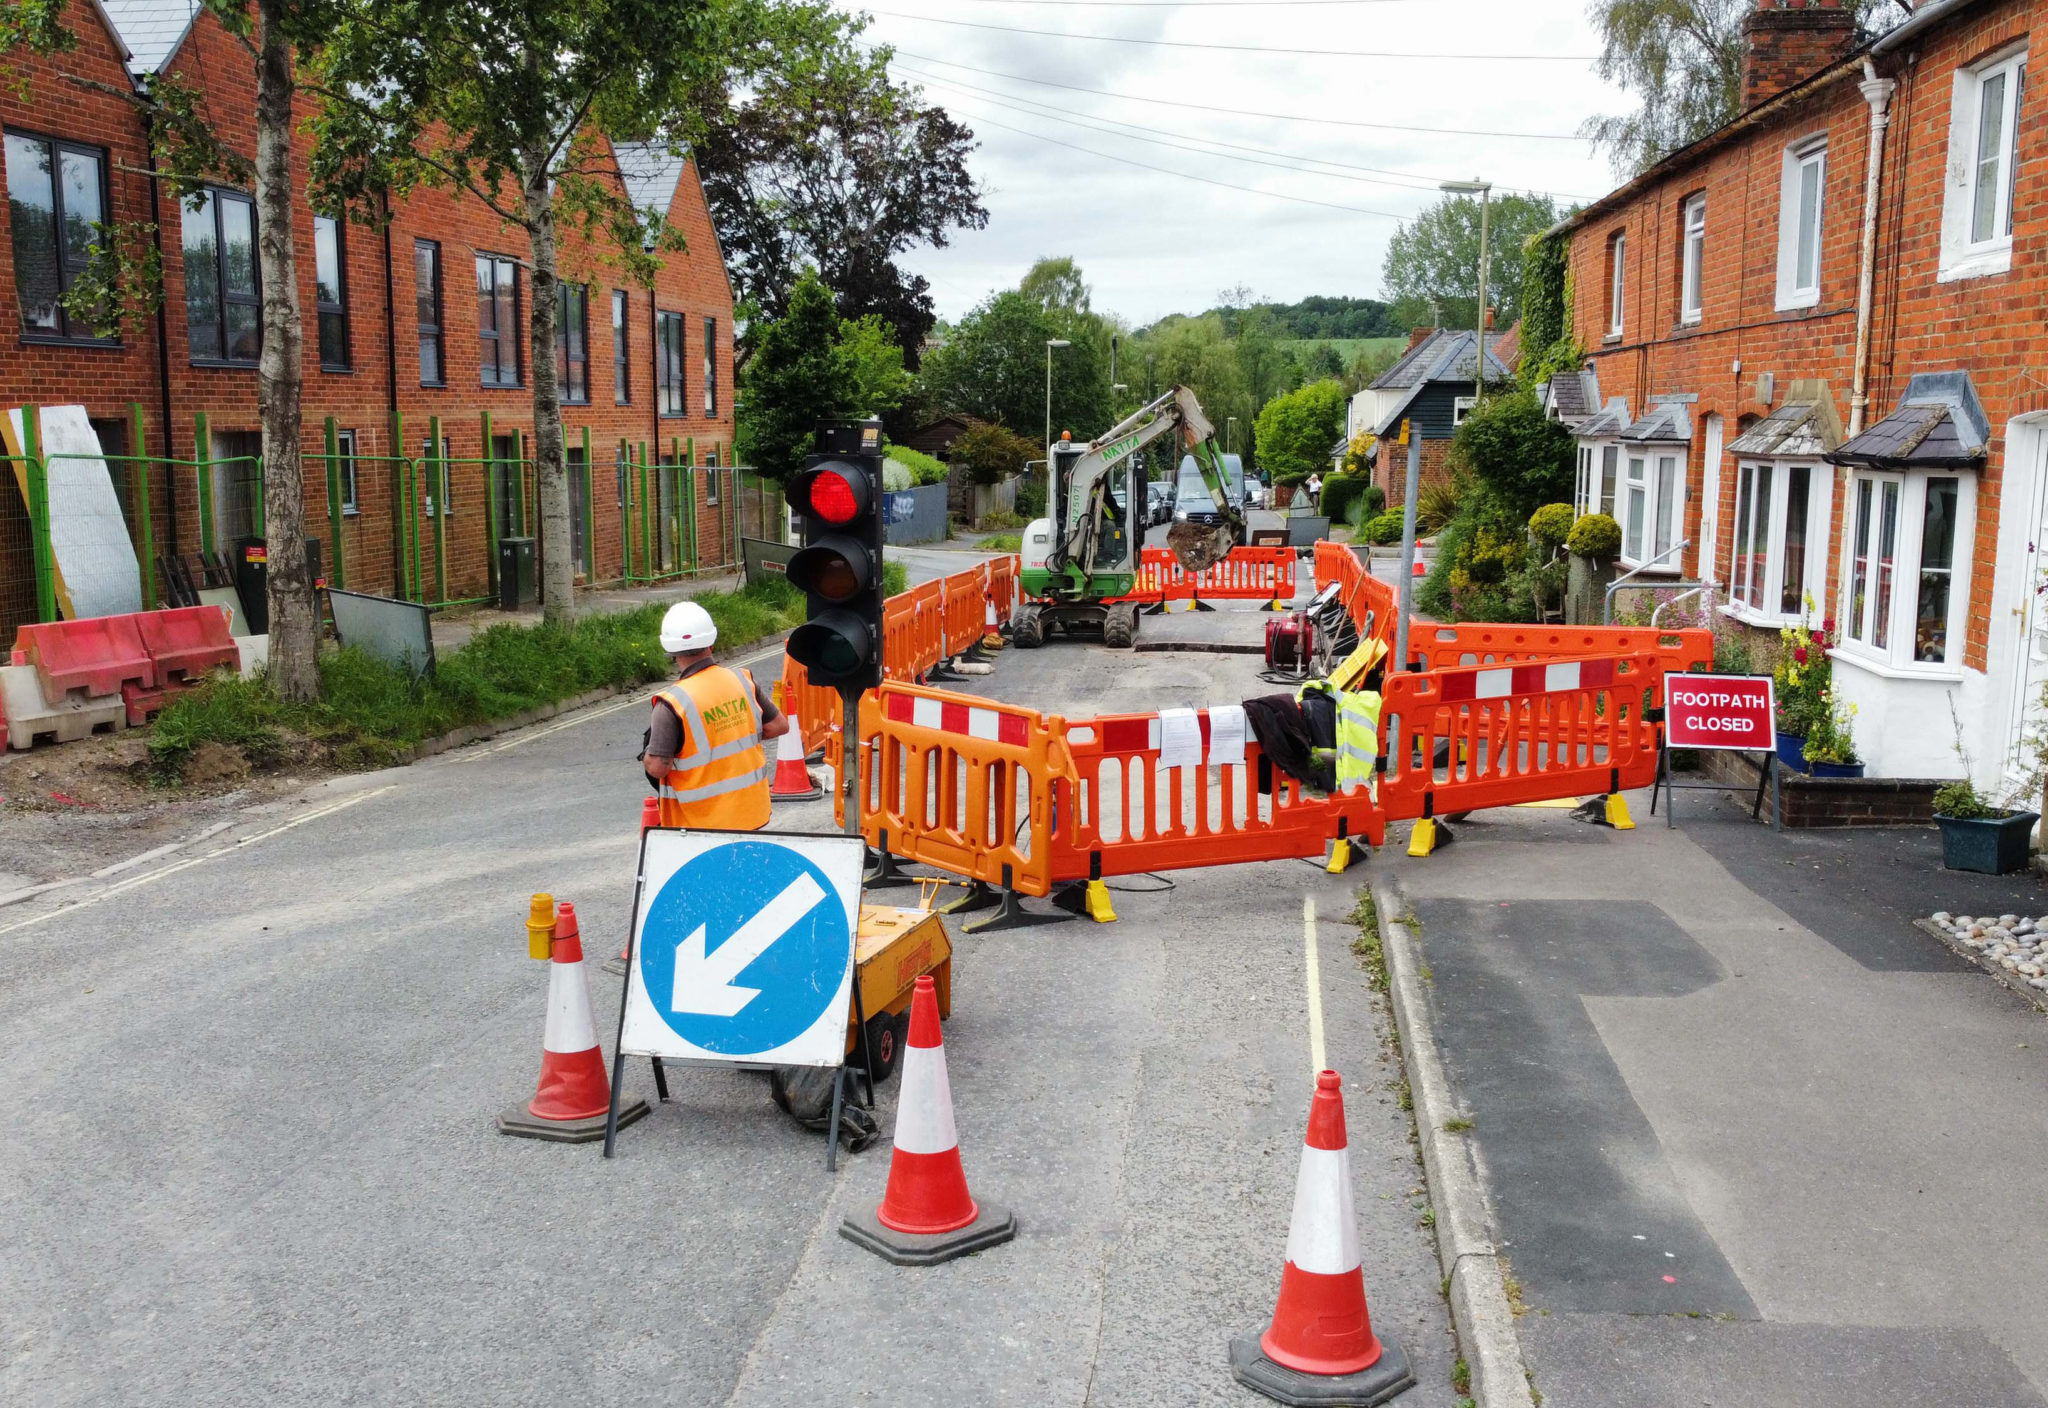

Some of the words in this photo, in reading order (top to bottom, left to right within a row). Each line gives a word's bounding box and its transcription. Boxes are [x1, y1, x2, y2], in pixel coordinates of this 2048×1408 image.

[1102, 435, 1140, 461] NATTA
[703, 697, 747, 725] NATTA
[1672, 691, 1765, 709] FOOTPATH
[1685, 716, 1754, 732] CLOSED
